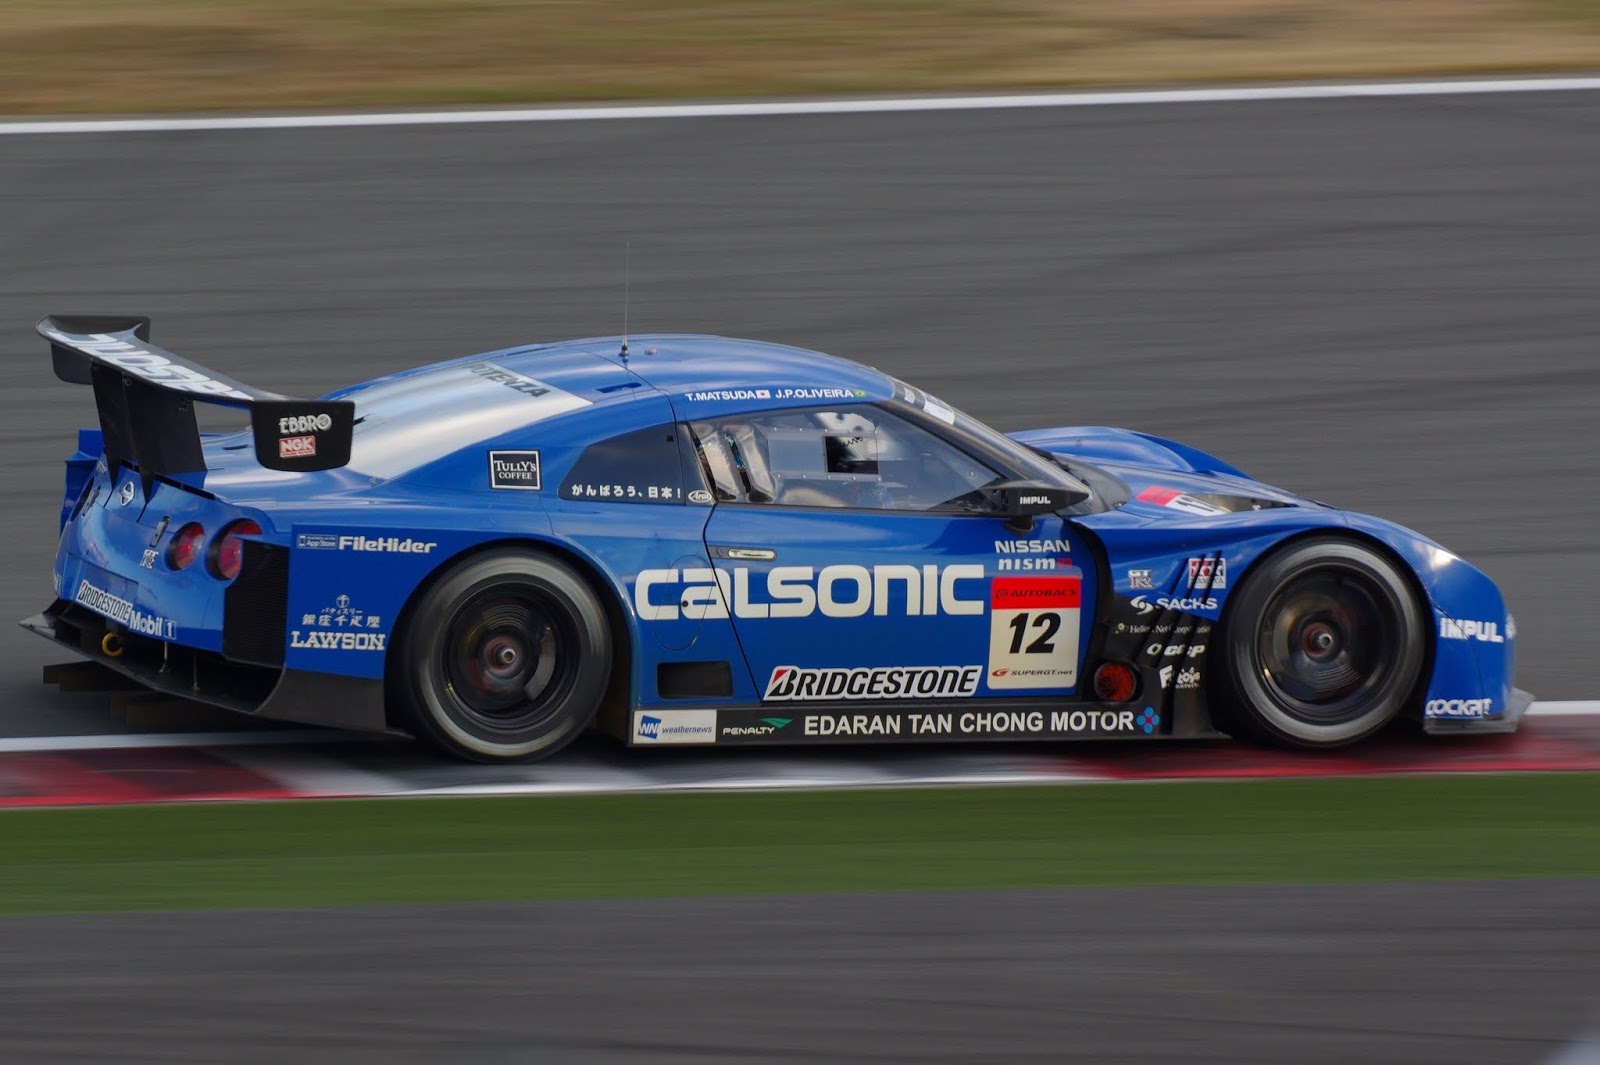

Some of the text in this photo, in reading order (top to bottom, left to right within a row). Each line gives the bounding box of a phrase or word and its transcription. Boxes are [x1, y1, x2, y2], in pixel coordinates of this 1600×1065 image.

[685, 389, 854, 401] T.MATSUDA J.P.OLIVEIRA
[279, 413, 332, 434] EBBRO
[280, 437, 314, 452] NGK
[498, 471, 533, 480] COFFEE
[1019, 495, 1051, 505] IMPUL
[338, 536, 438, 554] FileHider
[994, 539, 1071, 554] NISSAN
[77, 581, 132, 621] BRIDGESTONE
[1011, 588, 1076, 597] AUTOBACS
[129, 610, 164, 636] Mobil
[1439, 617, 1504, 643] IMPUL
[290, 630, 386, 651] LAWSON
[1009, 612, 1062, 654] 12
[767, 668, 980, 698] BRIDGESTONE
[662, 725, 712, 734] weathernews
[722, 726, 775, 736] PENALTY
[804, 711, 1135, 736] EDARAN TAN CHONG MOTOR
